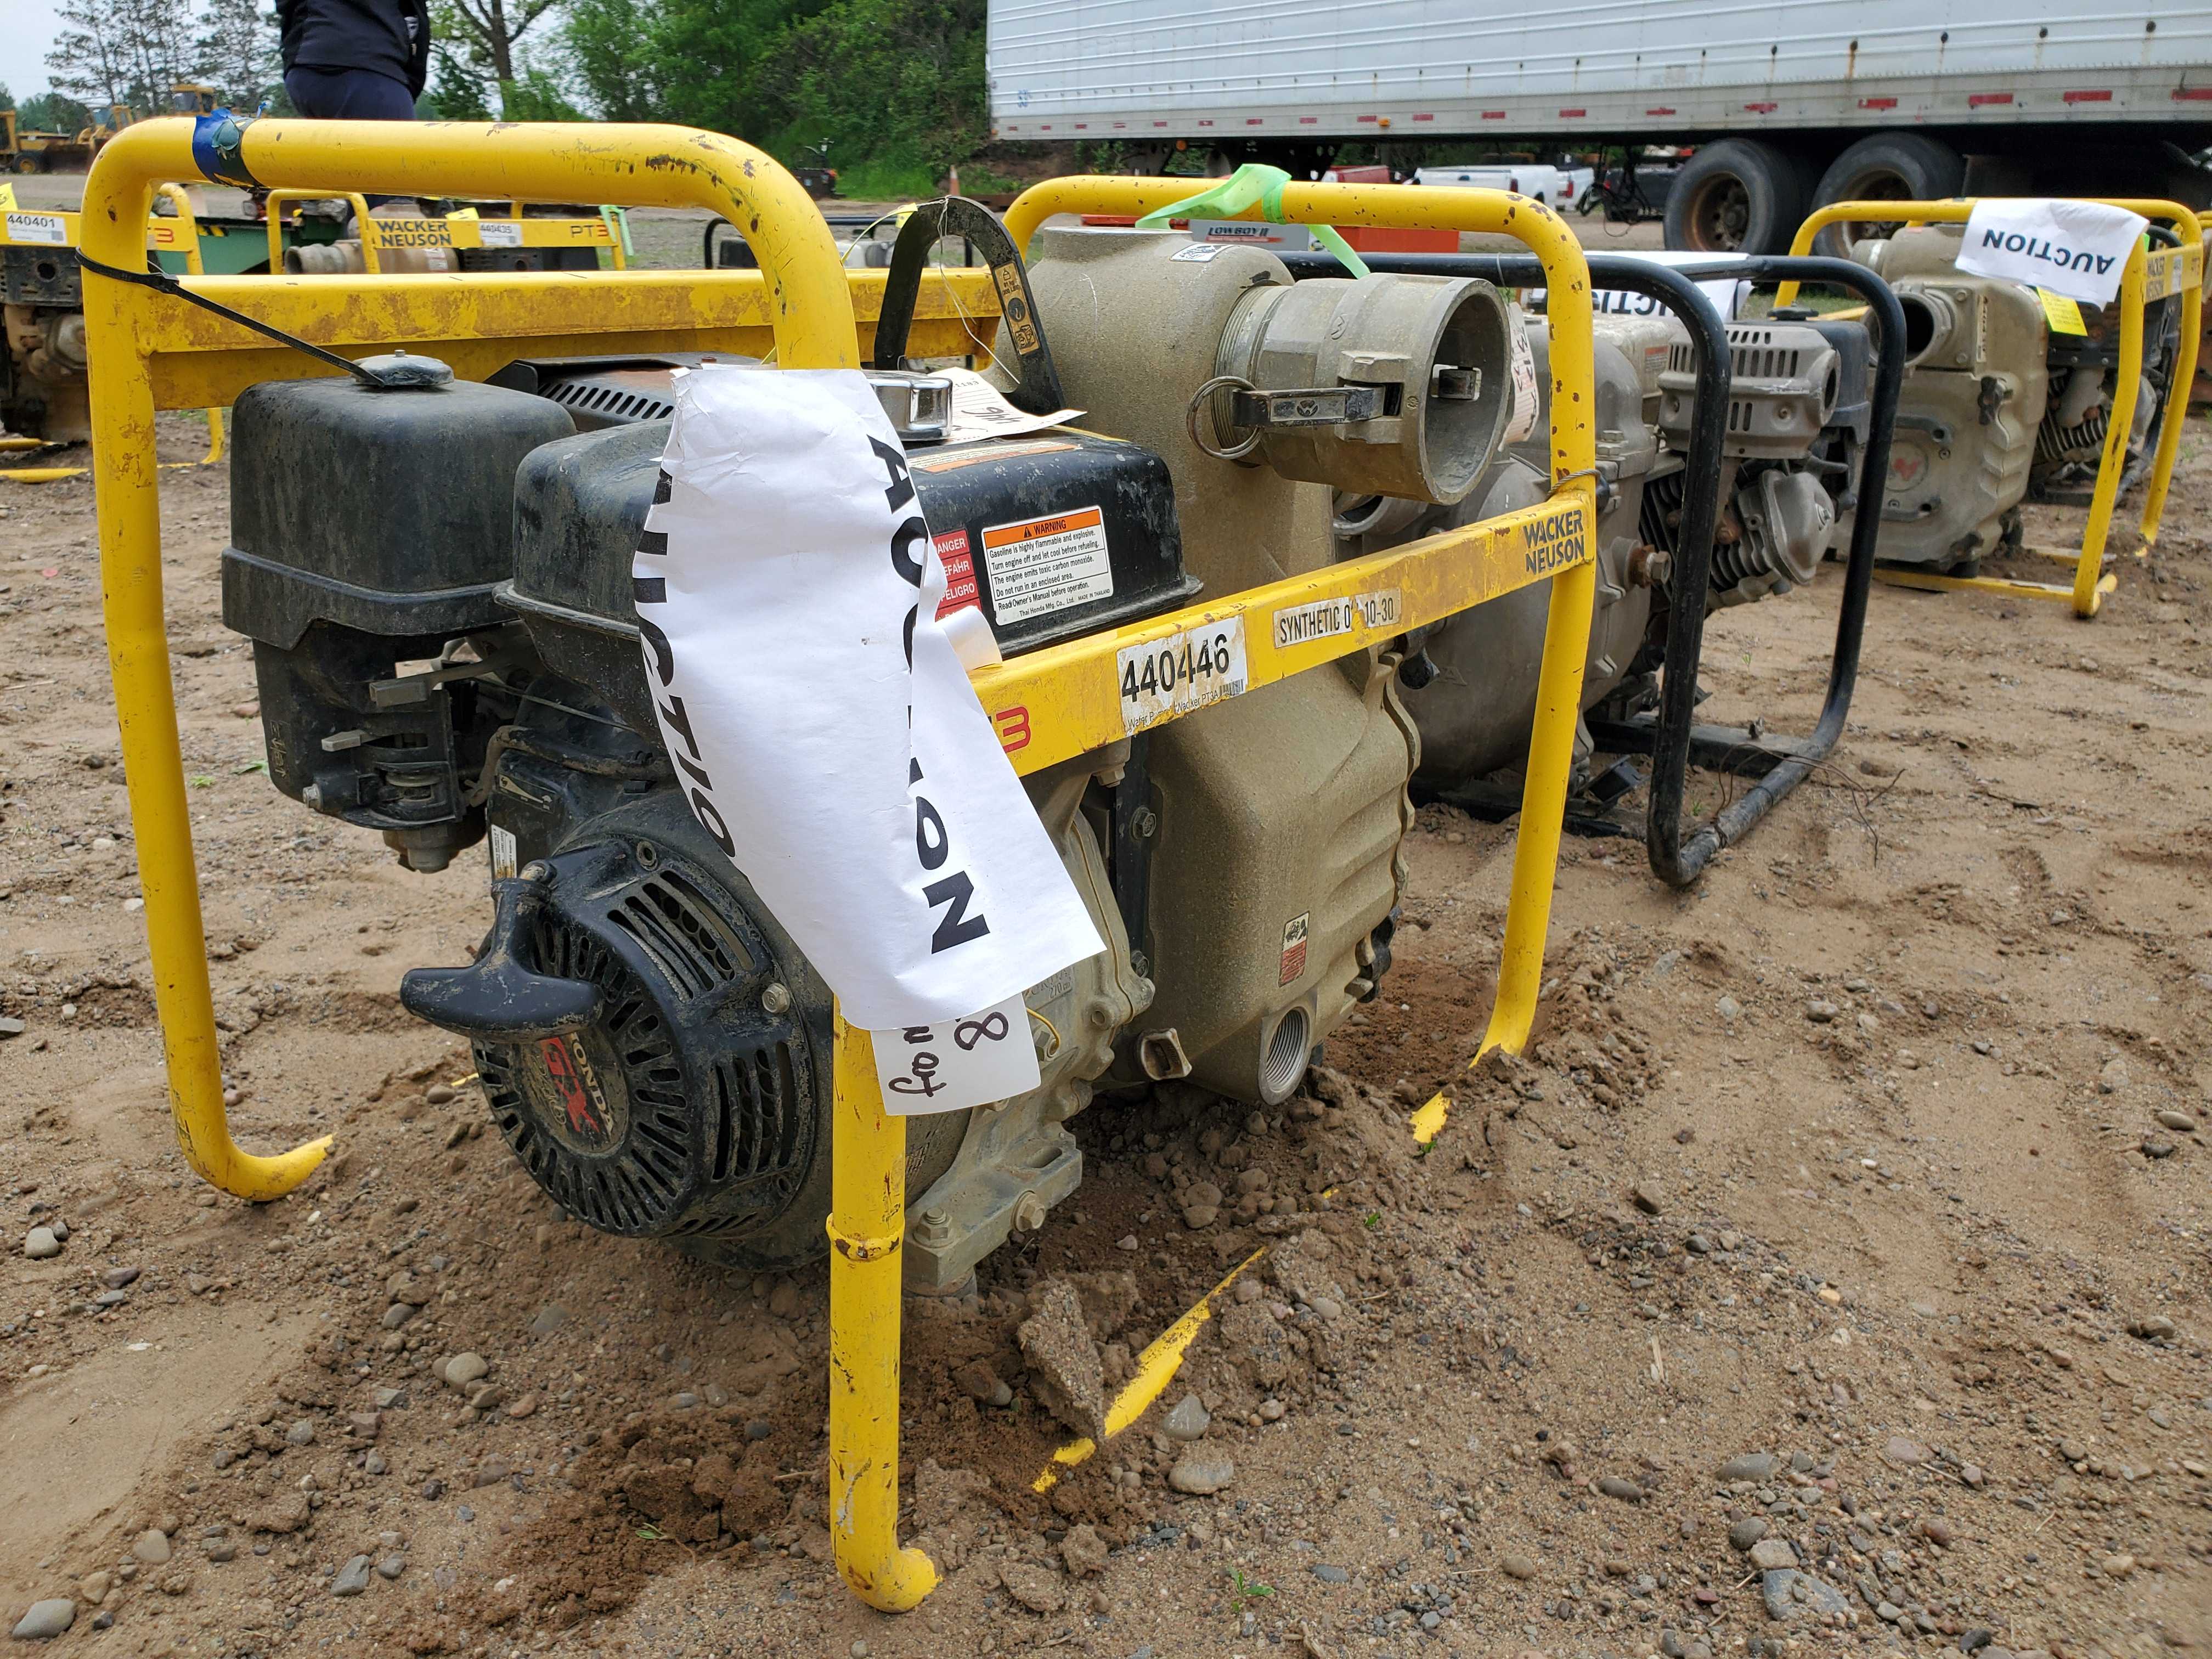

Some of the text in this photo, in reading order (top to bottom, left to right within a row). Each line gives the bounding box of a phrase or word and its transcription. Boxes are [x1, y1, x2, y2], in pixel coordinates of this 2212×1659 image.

[8, 215, 55, 228] 440401
[376, 221, 450, 232] WACKER
[381, 233, 452, 247] NEUSON
[1982, 229, 2116, 275] AUCTION
[1034, 519, 1066, 535] WARNING
[1522, 510, 1583, 549] WACKER
[937, 538, 966, 555] ANGER
[989, 529, 1096, 558] Gasoline is highly flammable and explosive.
[991, 562, 1004, 571] Turn
[1005, 558, 1023, 568] engine
[1031, 552, 1041, 561] and
[1042, 551, 1050, 560] let
[1050, 548, 1061, 557] cool
[1061, 545, 1077, 555] before
[1078, 540, 1100, 551] refueling.
[1525, 534, 1585, 575] NEUSON
[944, 560, 970, 577] EFAHR
[994, 554, 1094, 585] The engine emits toxic carbon monoxide.
[996, 589, 1004, 597] Do
[1005, 586, 1014, 595] not
[1014, 585, 1024, 593] run
[1024, 582, 1030, 590] in
[1038, 574, 1060, 587] enclosed
[1061, 572, 1074, 581] area.
[998, 581, 1090, 611] Read Owner's Manual before operation.
[1019, 608, 1030, 617] Thai
[1030, 605, 1045, 614] Honda
[1094, 588, 1111, 597] THAILAND
[1279, 605, 1341, 644] SYNTHETIC
[1120, 633, 1231, 704] 440446
[1201, 690, 1219, 709] PT3A
